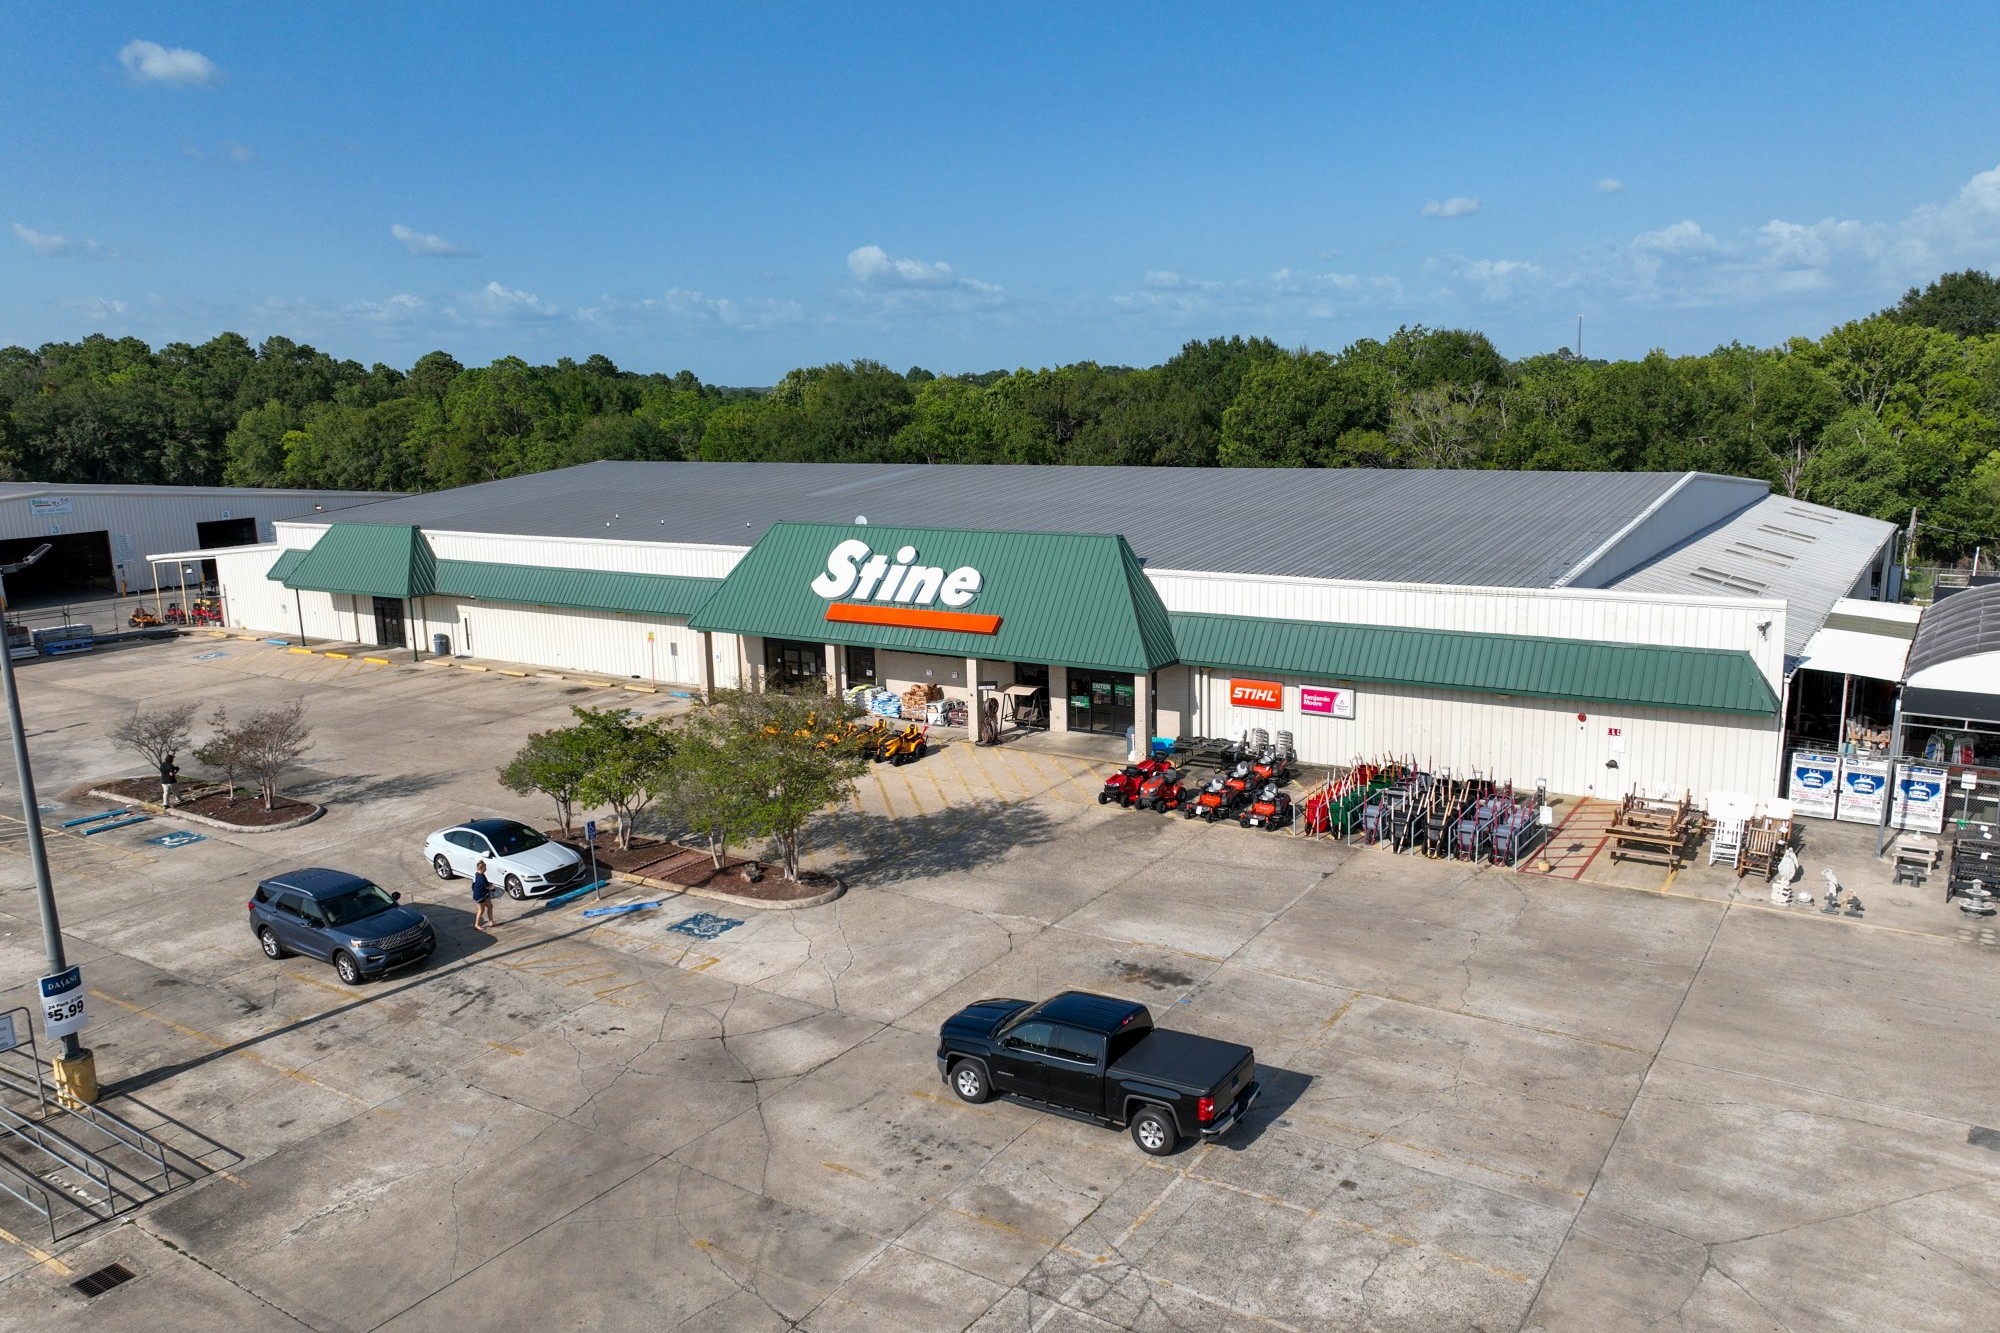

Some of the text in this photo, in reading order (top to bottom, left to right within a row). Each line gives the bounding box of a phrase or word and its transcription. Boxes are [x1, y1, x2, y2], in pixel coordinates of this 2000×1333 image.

[811, 539, 984, 609] Stine
[1232, 687, 1277, 702] STIHL
[1303, 693, 1331, 702] Benjamin
[1303, 699, 1323, 707] Moore
[48, 975, 77, 990] DASANI
[47, 1000, 84, 1021] $5.99
